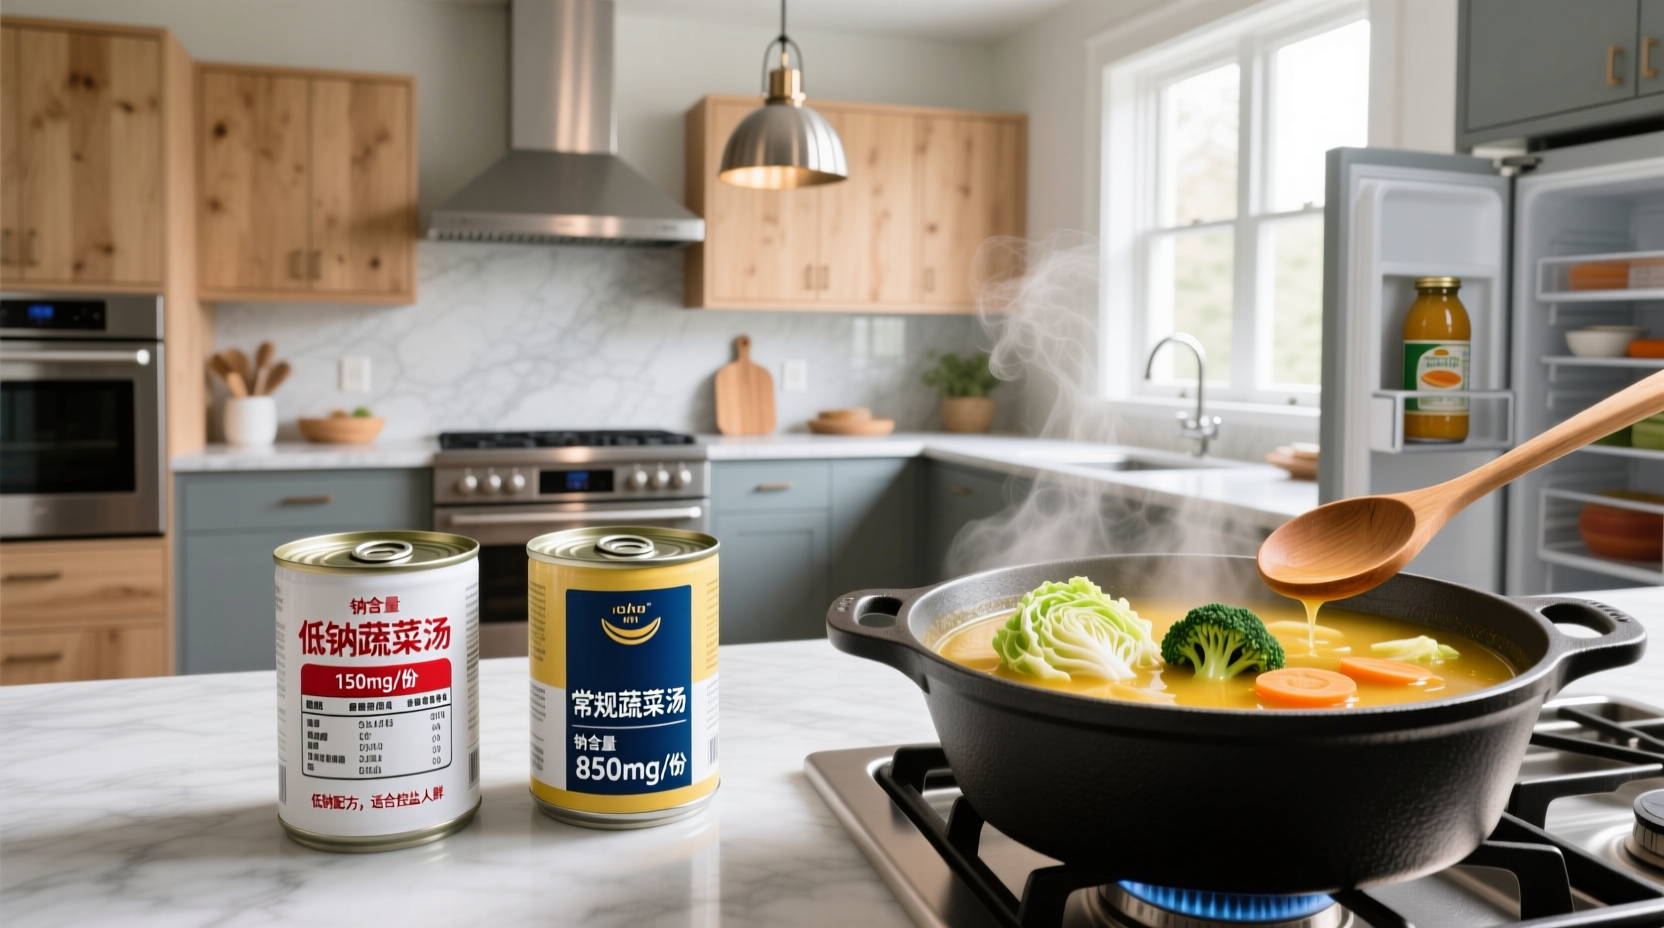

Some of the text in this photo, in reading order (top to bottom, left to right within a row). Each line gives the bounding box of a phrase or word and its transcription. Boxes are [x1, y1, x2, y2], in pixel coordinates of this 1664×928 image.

[299, 616, 451, 657] 低钠蔬菜汤
[335, 668, 419, 693] 150mg/份
[571, 686, 687, 719] 常规蔬菜汤
[575, 751, 687, 786] 850mg/份
